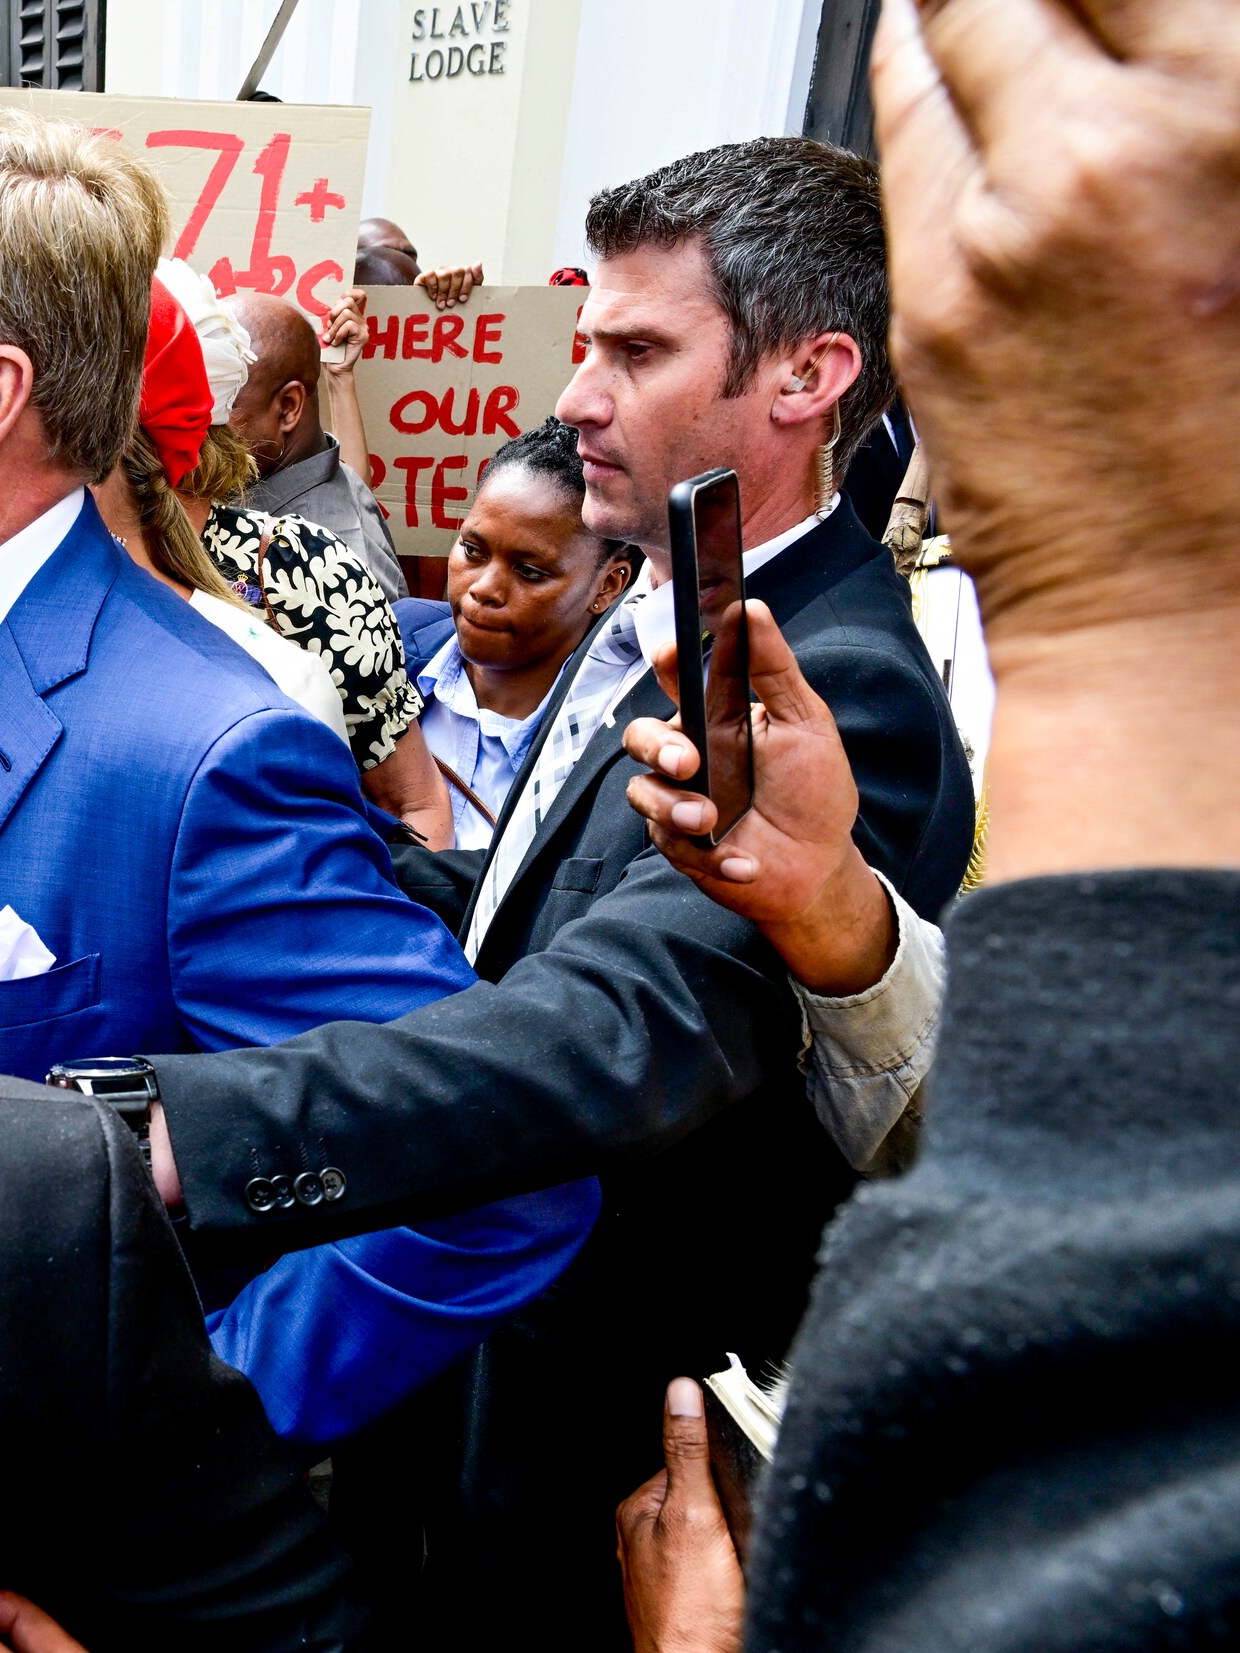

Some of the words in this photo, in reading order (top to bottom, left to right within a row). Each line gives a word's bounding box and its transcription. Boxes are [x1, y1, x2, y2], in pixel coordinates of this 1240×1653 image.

[412, 0, 510, 40] SLAVE
[409, 42, 508, 82] LODGE
[78, 127, 347, 288] 71+
[359, 297, 507, 365] HERE
[389, 384, 523, 438] OUR
